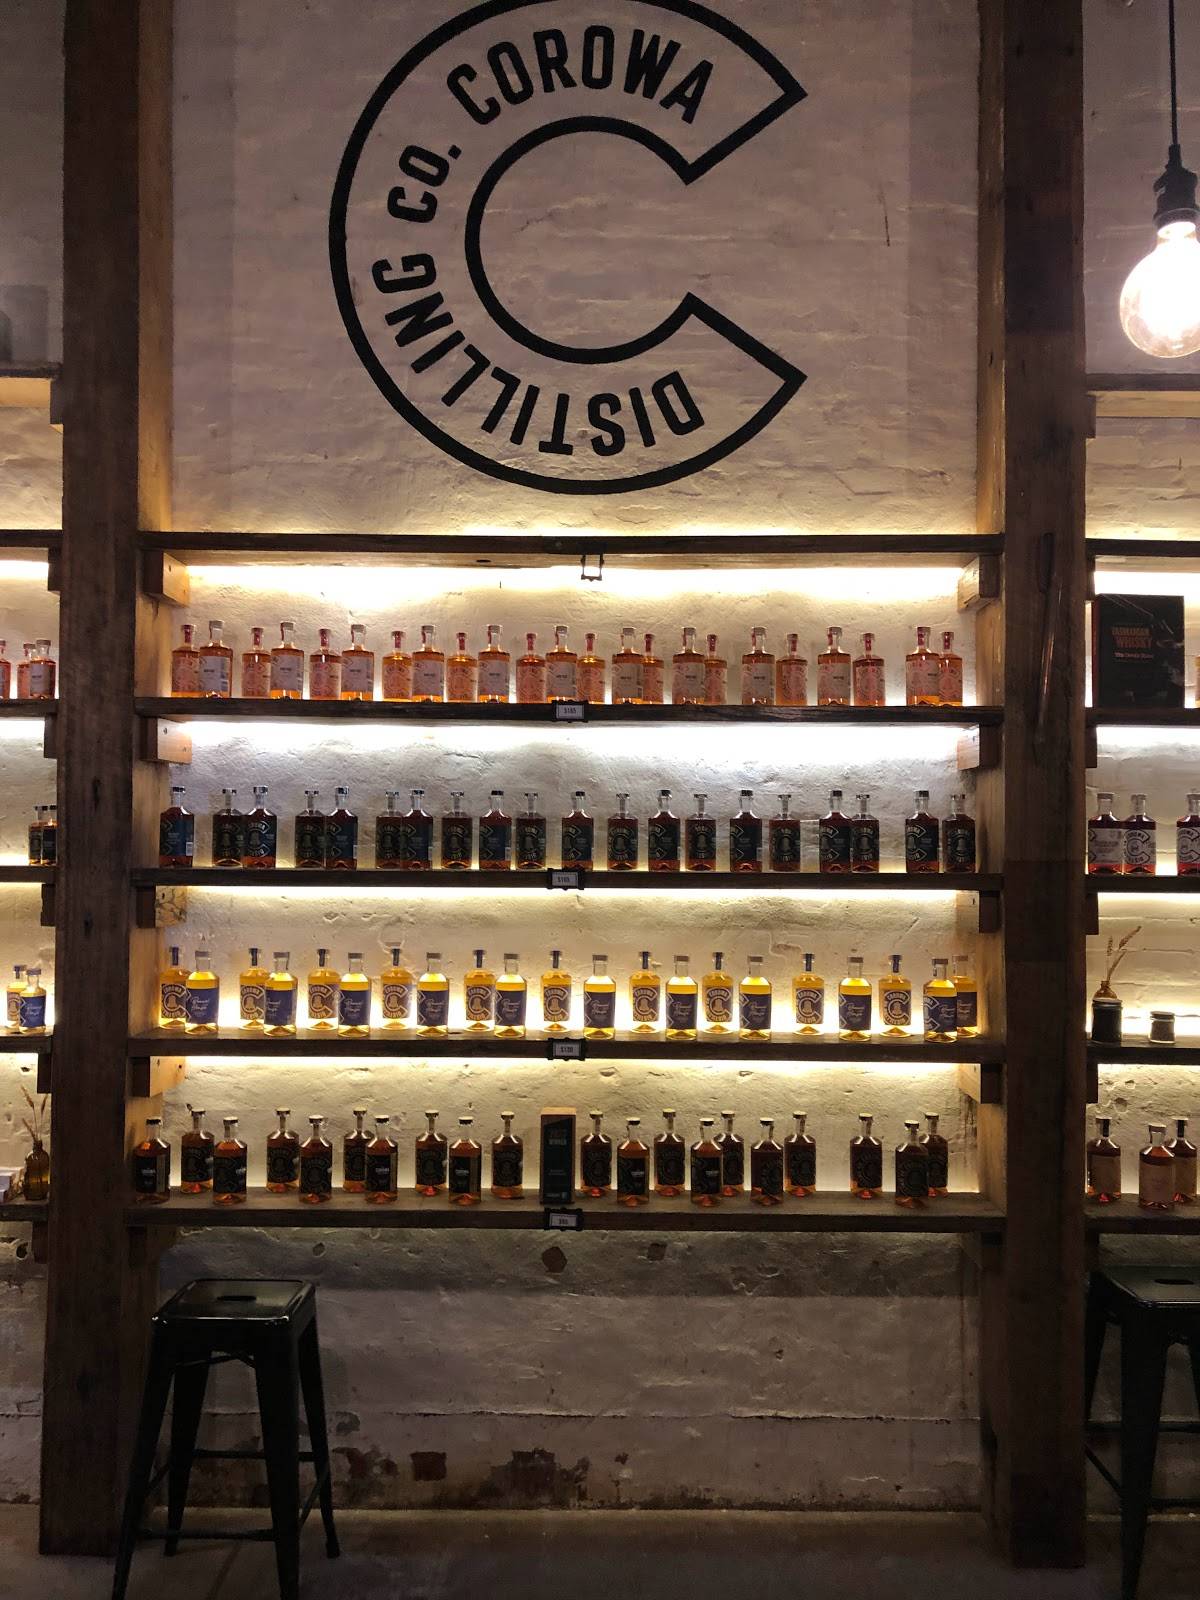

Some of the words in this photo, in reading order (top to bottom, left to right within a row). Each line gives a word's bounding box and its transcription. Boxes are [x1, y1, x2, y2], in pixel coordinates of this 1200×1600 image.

[446, 25, 714, 125] COROWA
[387, 145, 462, 223] CO.
[371, 253, 705, 456] DISTILLING
